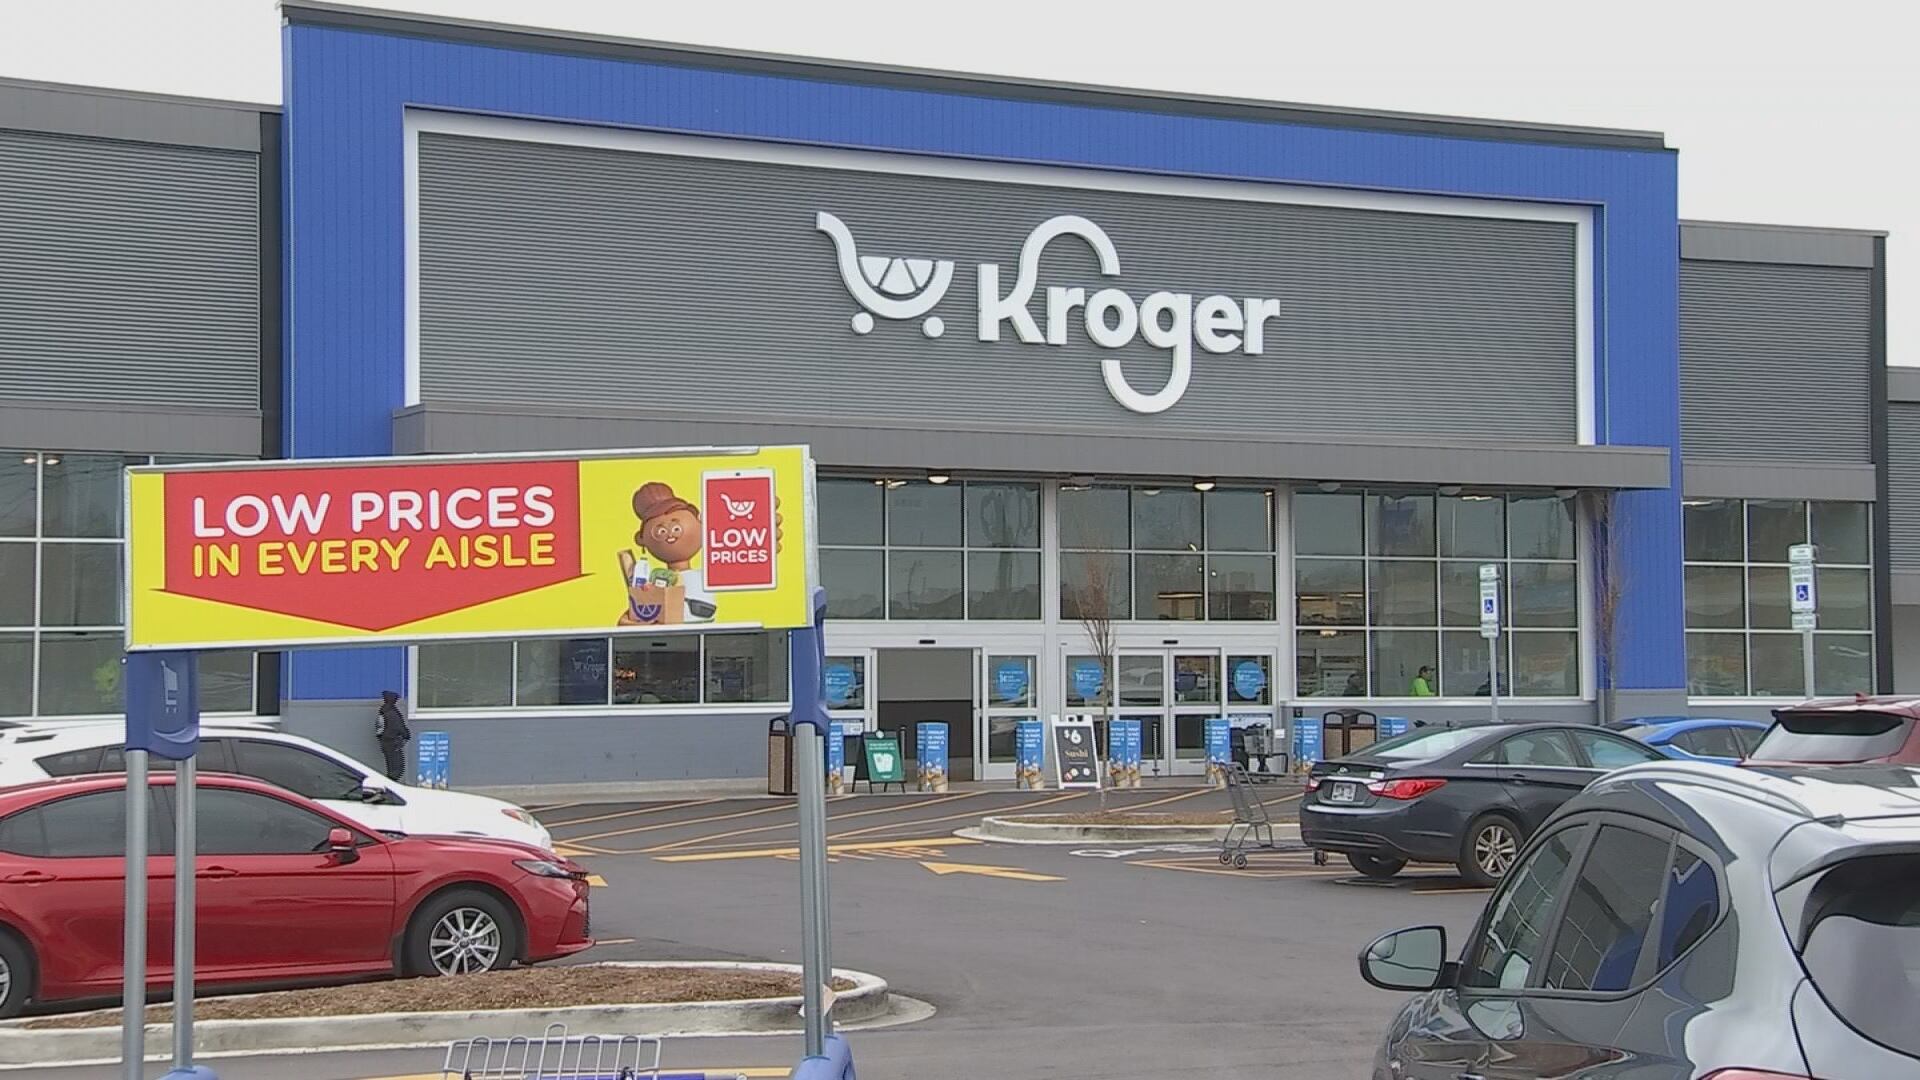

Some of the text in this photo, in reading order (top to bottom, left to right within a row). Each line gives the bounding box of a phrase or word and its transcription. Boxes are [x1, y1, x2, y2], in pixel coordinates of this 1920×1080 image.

[977, 215, 1281, 414] Kroger
[194, 485, 555, 538] LOW PRICES
[194, 533, 555, 578] IN EVERY AISLE
[710, 527, 768, 548] LOW
[711, 549, 768, 564] PRICES
